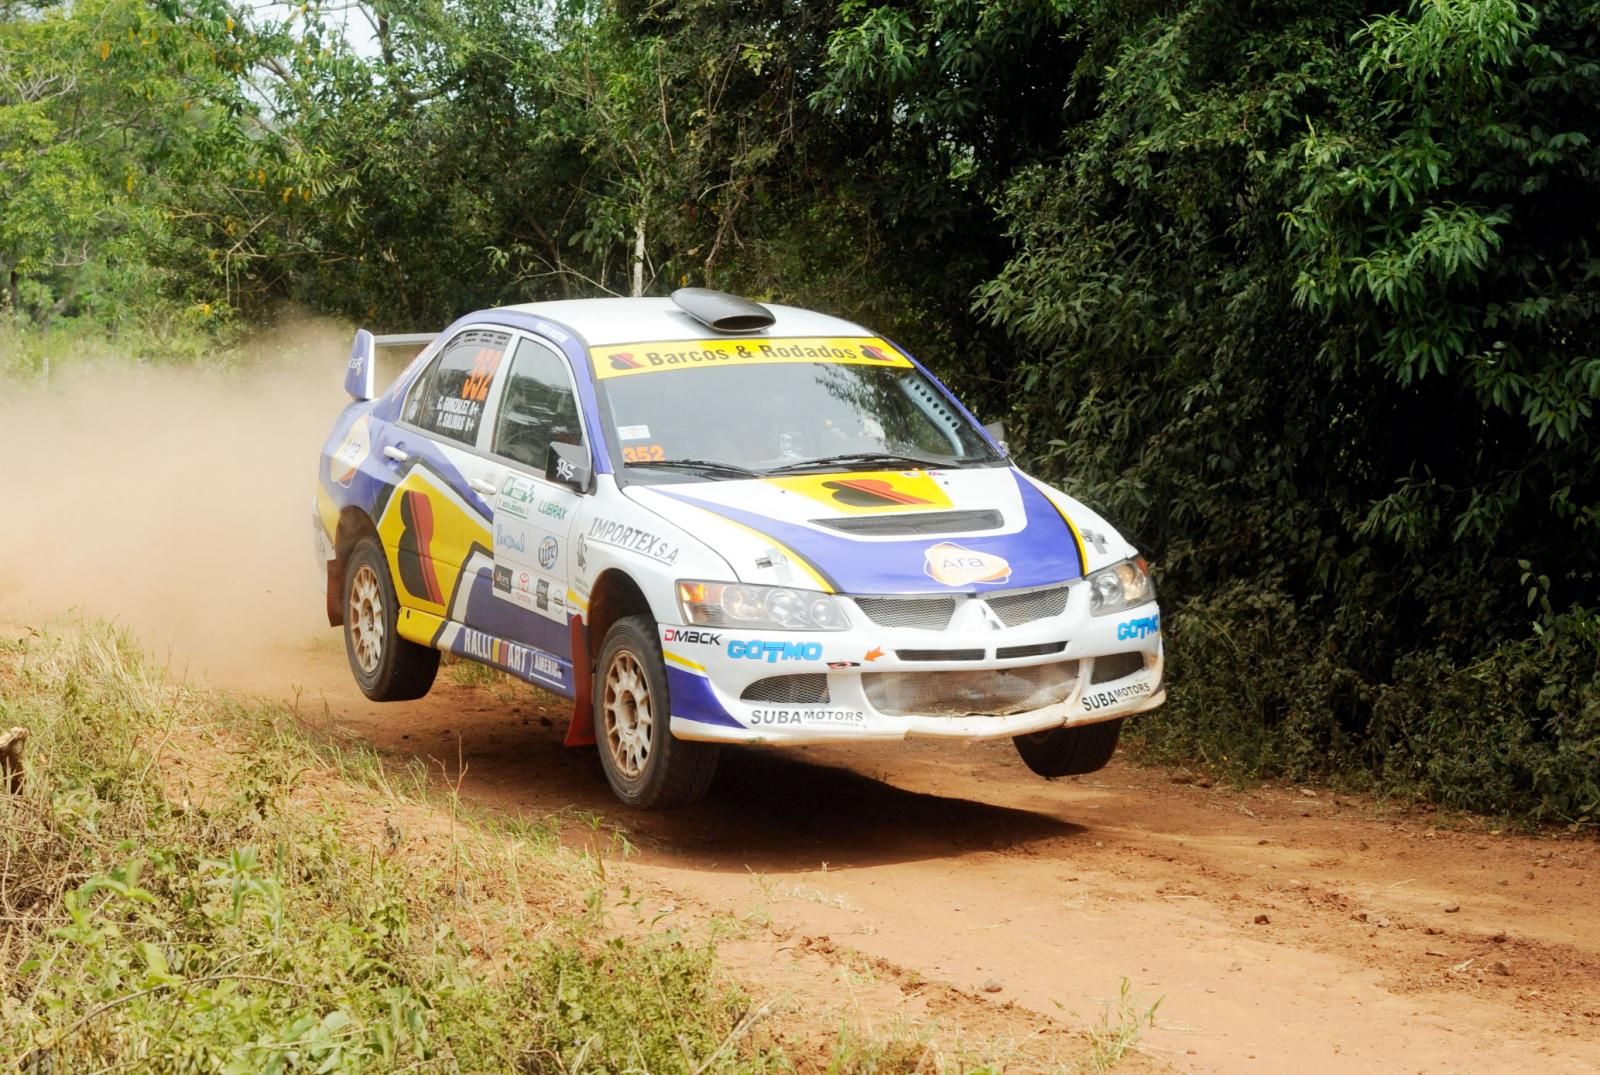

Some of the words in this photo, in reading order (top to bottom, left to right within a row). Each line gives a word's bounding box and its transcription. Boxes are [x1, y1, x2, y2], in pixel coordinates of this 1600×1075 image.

[646, 349, 729, 366] Barcos
[735, 345, 754, 359] &
[759, 344, 857, 359] Rodados
[623, 444, 666, 463] 352
[538, 499, 569, 520] LUBRAX
[588, 517, 661, 554] IMPORTEX
[943, 557, 985, 569] Ara
[464, 627, 492, 661] RALLI
[507, 643, 529, 673] ART
[727, 640, 823, 663] GOTMO
[1082, 691, 1118, 711] SUBA
[1113, 682, 1151, 699] MOTORS
[751, 710, 802, 724] SUBA
[804, 711, 863, 722] MOTORS
